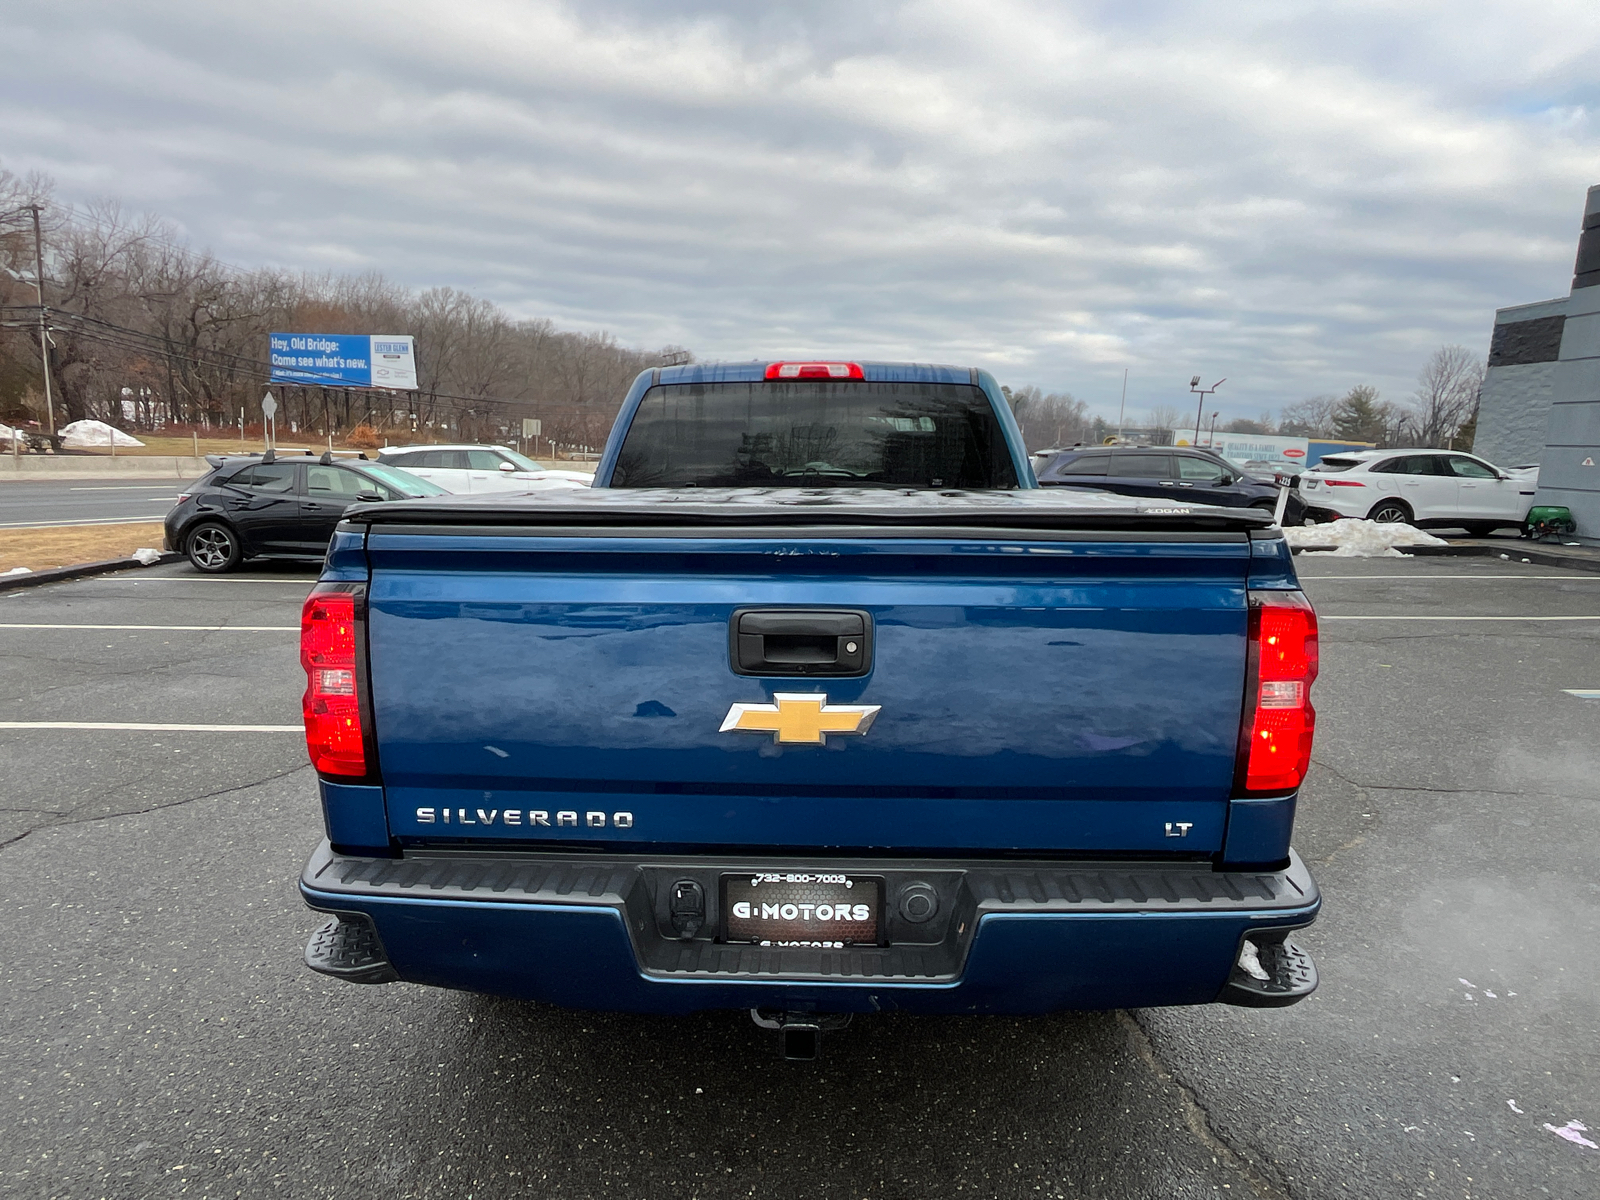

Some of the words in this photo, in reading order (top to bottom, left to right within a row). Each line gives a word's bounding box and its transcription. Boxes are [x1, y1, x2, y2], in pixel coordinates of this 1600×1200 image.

[271, 337, 289, 351] Hey,
[291, 338, 305, 350] Old
[307, 338, 339, 353] Bridge:
[272, 354, 296, 366] Come
[298, 357, 313, 366] see
[315, 355, 345, 368] what's
[346, 358, 367, 368] new.
[416, 807, 633, 828] SILVERADO
[1165, 822, 1193, 837] LT
[755, 873, 846, 884] 732-800-7003
